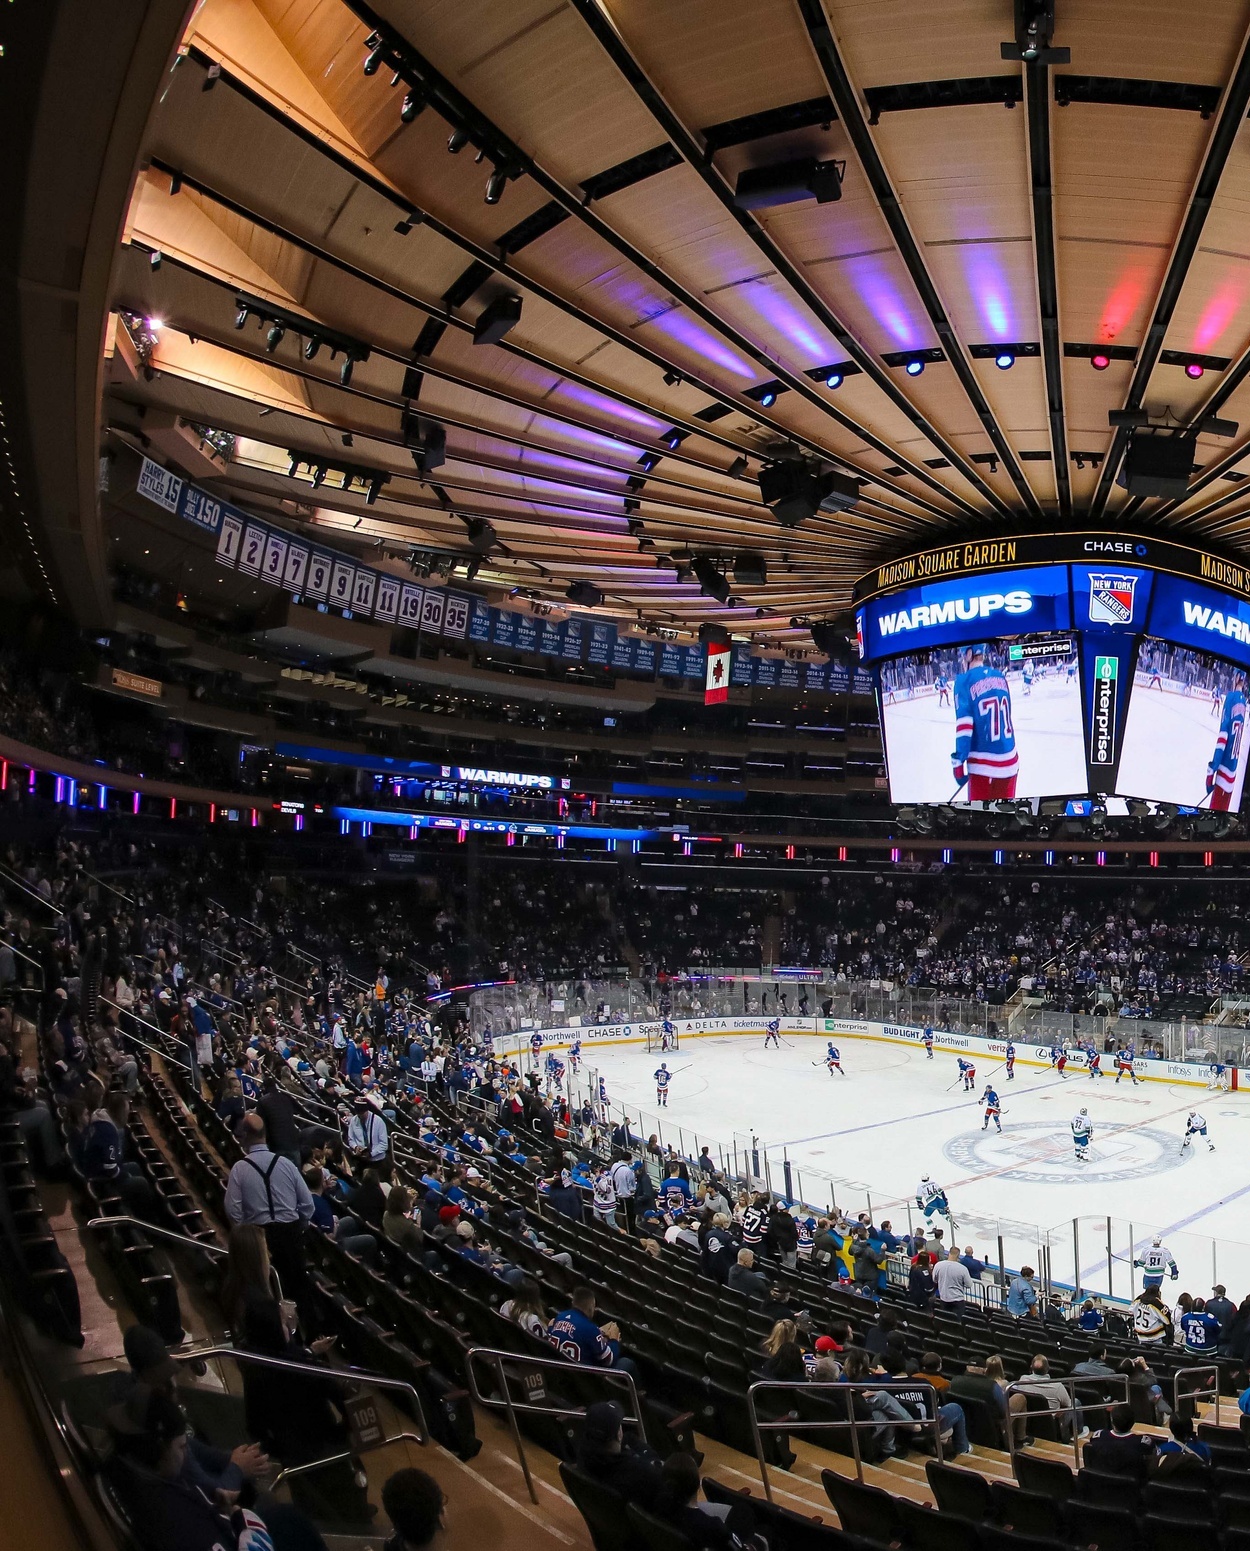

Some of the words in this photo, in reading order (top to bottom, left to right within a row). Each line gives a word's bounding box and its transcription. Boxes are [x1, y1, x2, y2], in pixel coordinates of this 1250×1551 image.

[144, 460, 166, 481] HARRY
[140, 472, 165, 496] STYLES
[165, 476, 180, 503] 15
[196, 497, 221, 528] 150
[224, 531, 233, 554] 1
[247, 540, 258, 564] 2
[1084, 541, 1133, 553] CHASE
[269, 550, 280, 573] 3
[291, 559, 301, 581] 7
[878, 559, 915, 588] MADISON
[918, 550, 960, 576] SQUARE
[964, 542, 1017, 567] GARDEN
[1201, 554, 1243, 589] MADISON
[314, 567, 325, 589] 9
[337, 575, 347, 596] 9
[1094, 580, 1111, 589] NEW
[1113, 581, 1132, 590] YORK
[356, 582, 370, 604] 11
[380, 590, 394, 612] 11
[402, 596, 419, 618] 19
[423, 602, 442, 624] 30
[878, 590, 1034, 636] WARMUPS
[1098, 590, 1129, 620] RANGERS
[446, 607, 467, 630] 35
[1012, 643, 1071, 657] enterprise
[979, 696, 1014, 743] 71
[1096, 658, 1112, 763] enterprise
[458, 767, 552, 788] WARMUPS
[799, 974, 819, 982] ULTRA
[588, 1027, 621, 1038] CHASE
[695, 1020, 728, 1029] DELTA
[826, 1021, 868, 1032] enterprise
[883, 1026, 898, 1036] BUD
[900, 1029, 920, 1040] LIGHT
[543, 1031, 581, 1042] Northwell
[935, 1034, 969, 1047] Northwell
[987, 1043, 1006, 1053] veriz
[1167, 1064, 1192, 1076] Infosys
[1075, 1119, 1083, 1130] 32
[926, 1186, 938, 1197] 44
[743, 1211, 761, 1232] 27
[1149, 1256, 1161, 1267] 81
[1135, 1308, 1151, 1329] 25
[1187, 1325, 1206, 1344] 43
[524, 1373, 543, 1389] 109
[895, 1391, 924, 1401] NARIN
[352, 1406, 377, 1428] 109
